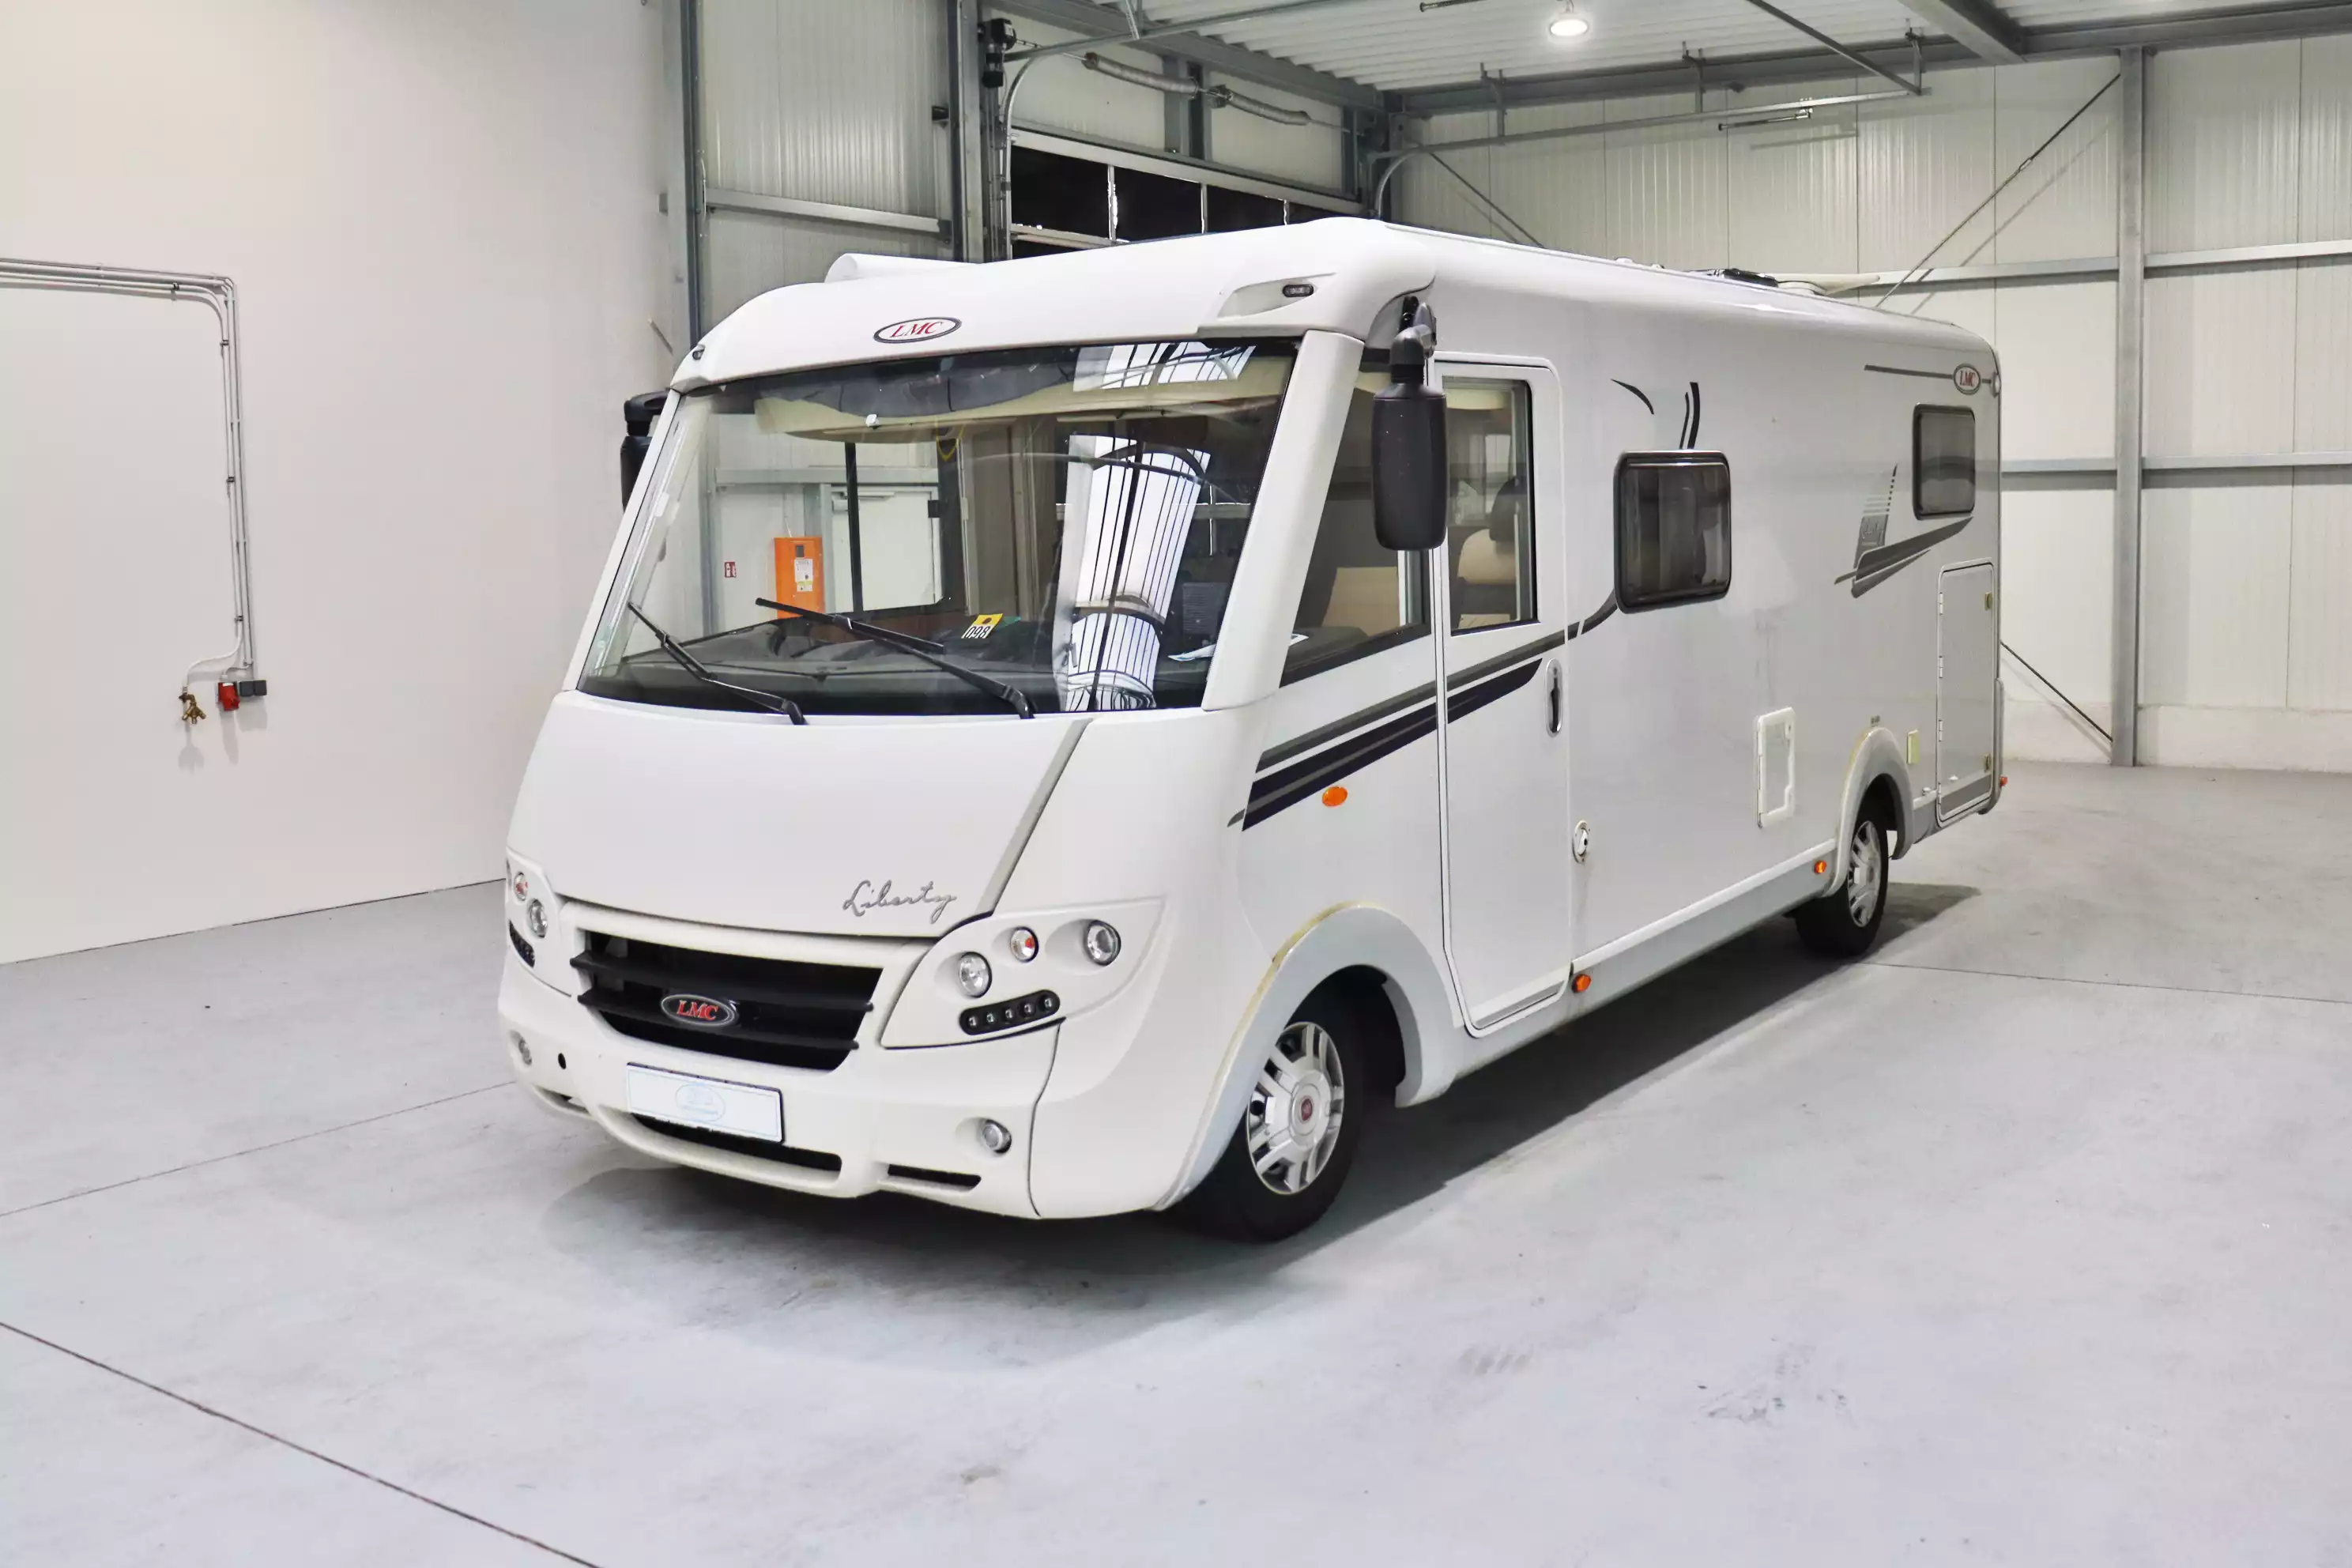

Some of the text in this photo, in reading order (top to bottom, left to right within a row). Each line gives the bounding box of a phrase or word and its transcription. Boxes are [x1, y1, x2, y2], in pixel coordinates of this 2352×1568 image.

[889, 321, 944, 338] LMC
[1959, 370, 1976, 387] LMC
[842, 879, 958, 925] Liberty
[677, 999, 718, 1021] LMC
